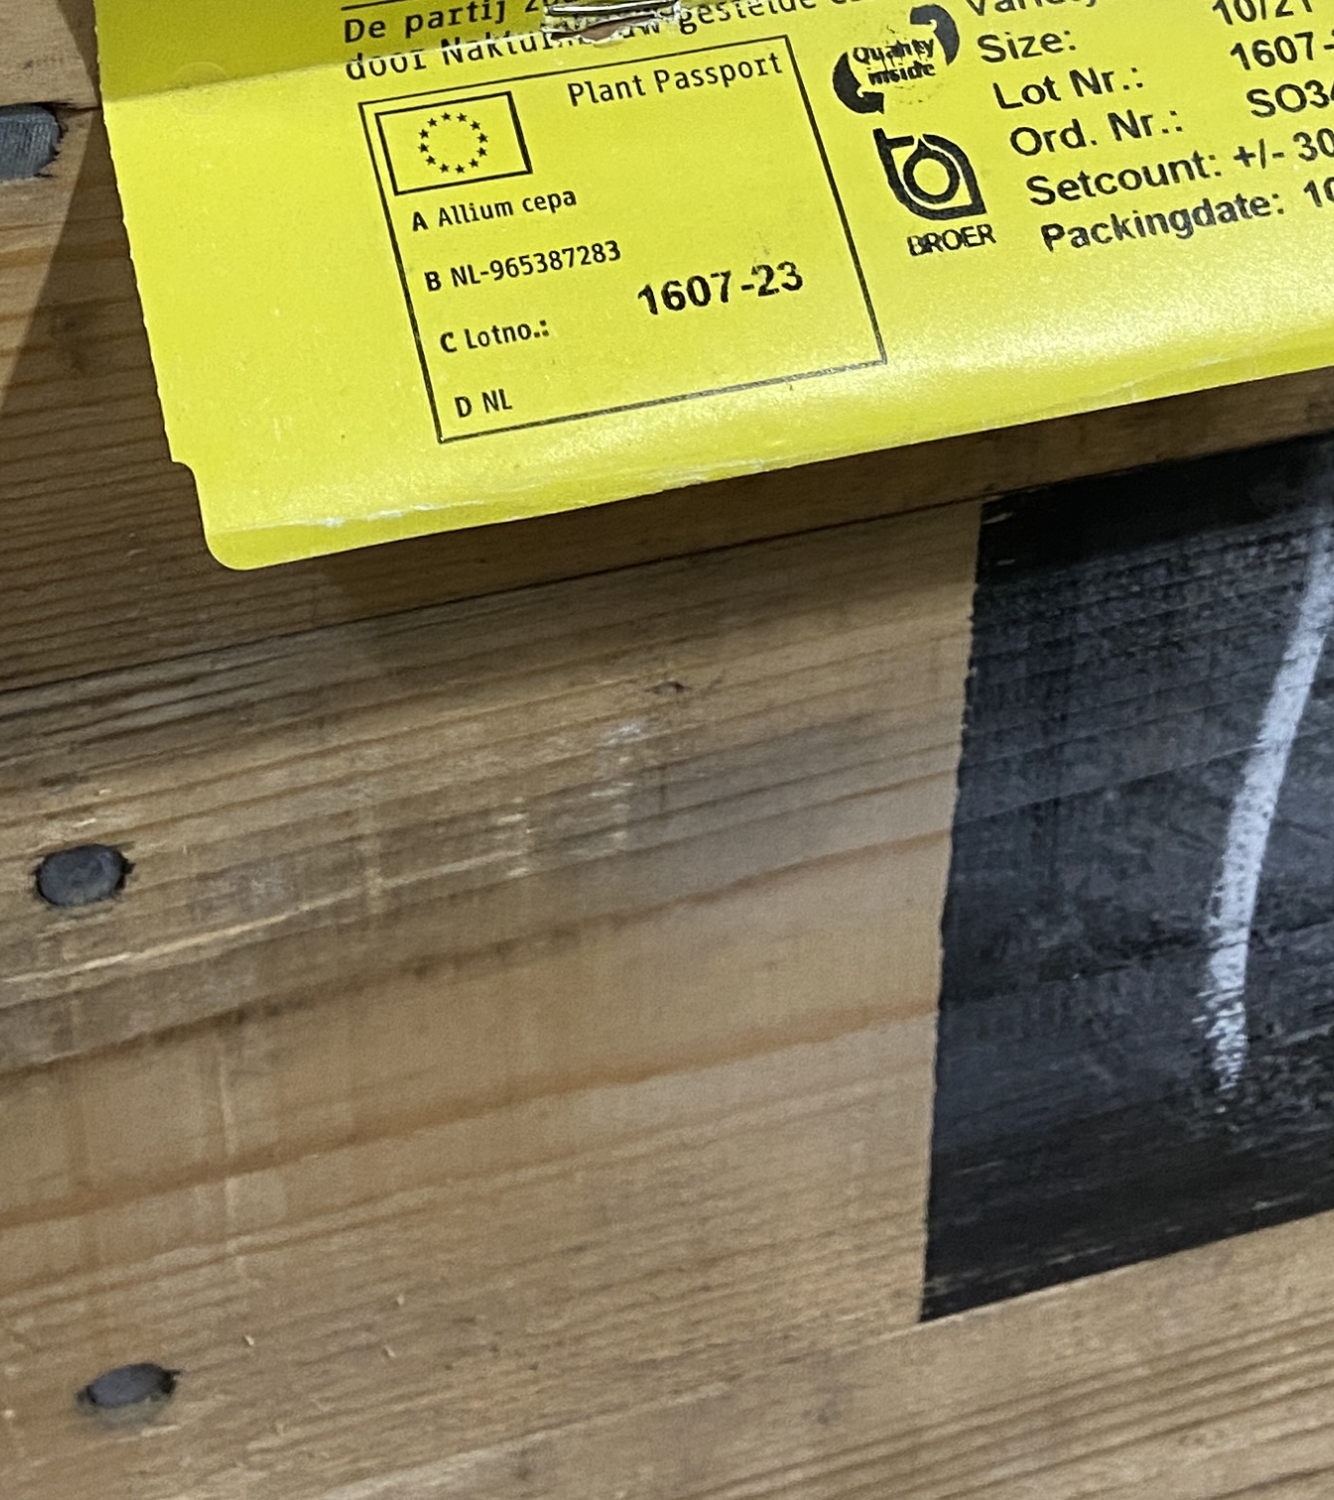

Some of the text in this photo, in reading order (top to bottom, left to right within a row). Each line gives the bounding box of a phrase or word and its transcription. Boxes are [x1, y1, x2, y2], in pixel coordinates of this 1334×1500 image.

[344, 18, 387, 44] De
[976, 30, 1077, 64] Size:
[345, 48, 427, 81] door
[567, 52, 783, 107] Plant Passport
[992, 75, 1062, 110] Lot
[1068, 66, 1144, 98] Nr.:
[1009, 118, 1098, 157] Ord.
[1106, 108, 1183, 142] Nr.:
[1028, 153, 1222, 209] Setcount:
[1232, 138, 1285, 170] +/-
[412, 190, 577, 232] A Allium cepa
[1040, 192, 1285, 253] Packingdate:
[906, 223, 997, 257] BROER
[423, 239, 621, 292] B NL-965387283
[439, 260, 804, 354] C Lotno.: 1607-23
[454, 388, 513, 419] D NL
